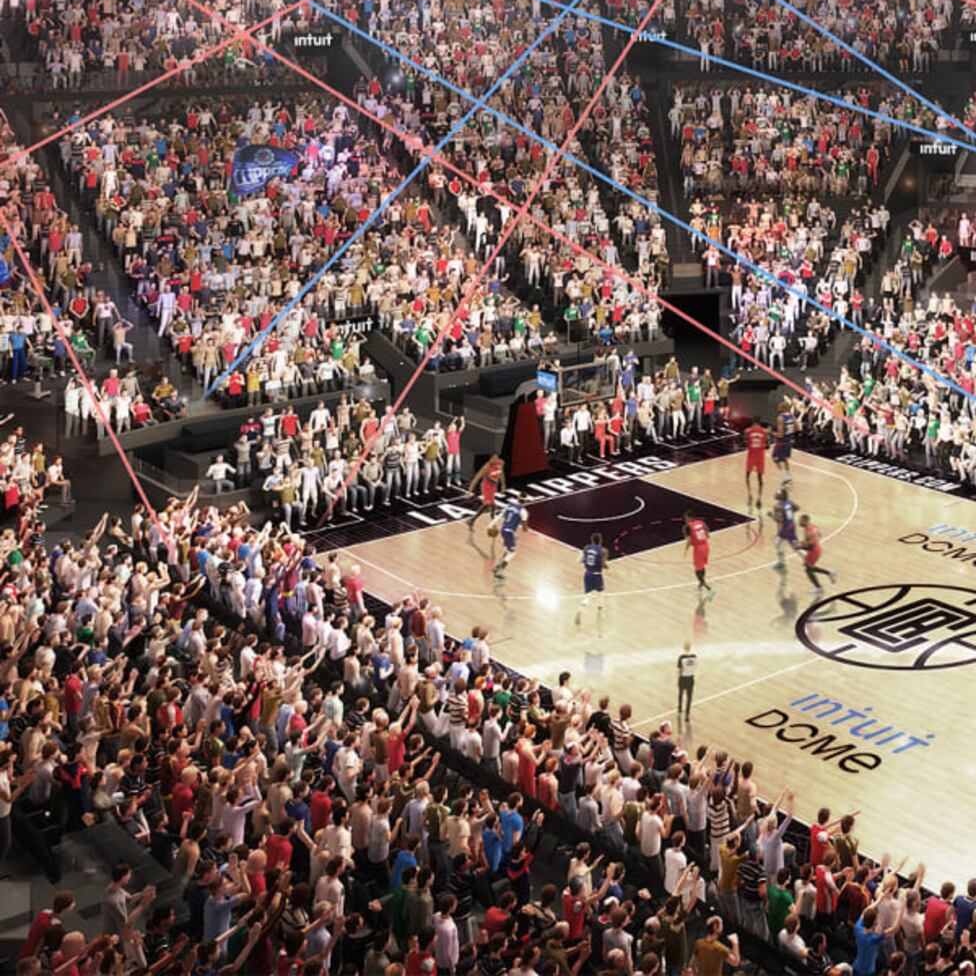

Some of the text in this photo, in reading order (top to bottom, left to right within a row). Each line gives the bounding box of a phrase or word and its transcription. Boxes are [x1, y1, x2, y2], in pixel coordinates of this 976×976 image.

[294, 32, 333, 47] intuit
[920, 142, 958, 155] intuit
[406, 502, 476, 526] LA
[790, 694, 938, 756] intuit
